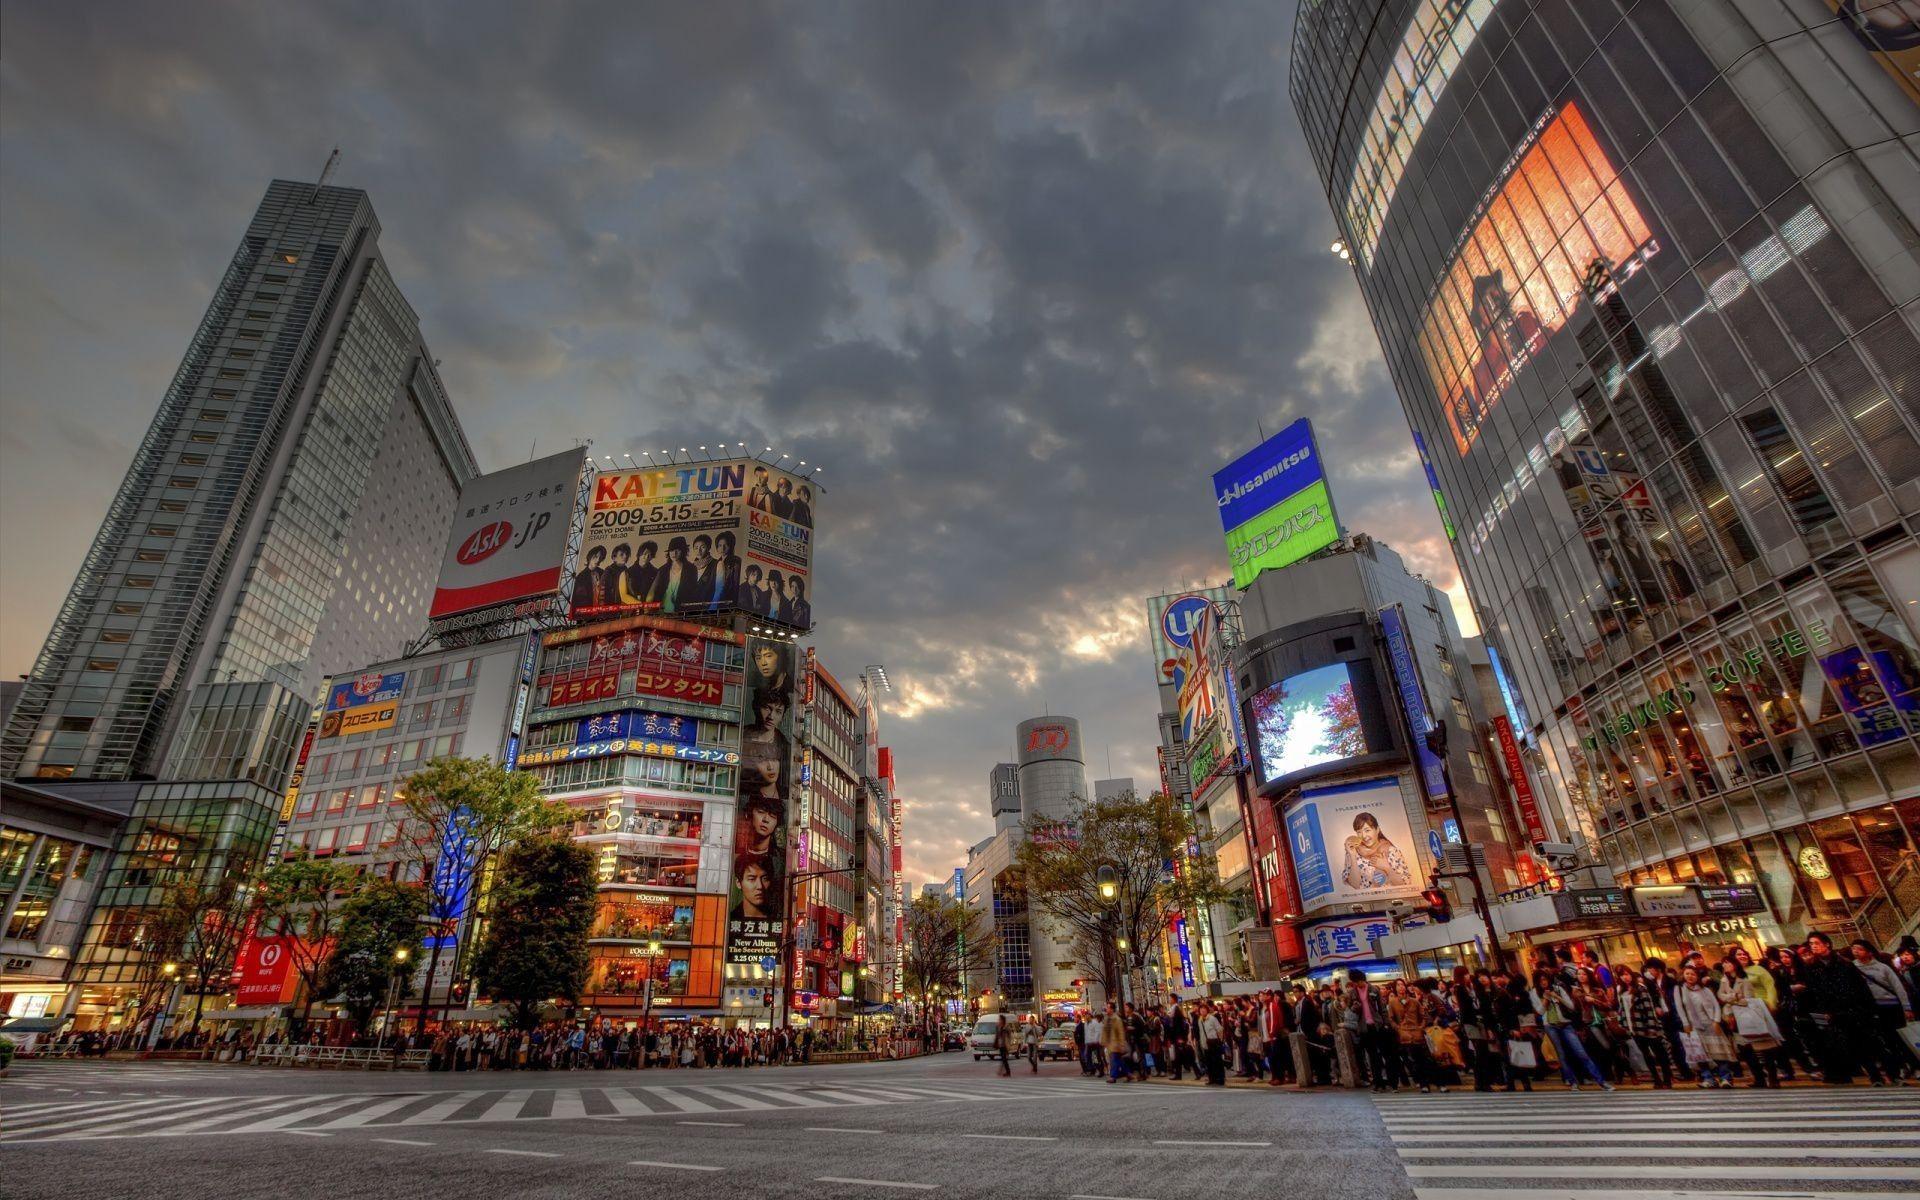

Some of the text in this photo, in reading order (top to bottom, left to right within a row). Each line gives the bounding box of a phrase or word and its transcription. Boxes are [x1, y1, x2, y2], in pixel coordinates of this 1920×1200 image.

[596, 464, 746, 502] KAT-TUN
[1218, 446, 1310, 507] Hisamitsu
[466, 484, 563, 518] 最速ブログ検索
[591, 503, 692, 529] 2009.5.15
[750, 510, 810, 543] KAT-TUN
[1232, 504, 1324, 566] サロンパス
[553, 676, 616, 701] プライス
[638, 674, 720, 698] コンタクト
[343, 711, 378, 728] プロミス
[610, 741, 625, 752] 6F
[725, 752, 739, 764] 6F
[1519, 793, 1545, 841] 三千里
[1580, 902, 1611, 914] 渋谷駅
[730, 921, 783, 933] 東方神起
[735, 939, 776, 947] New Album
